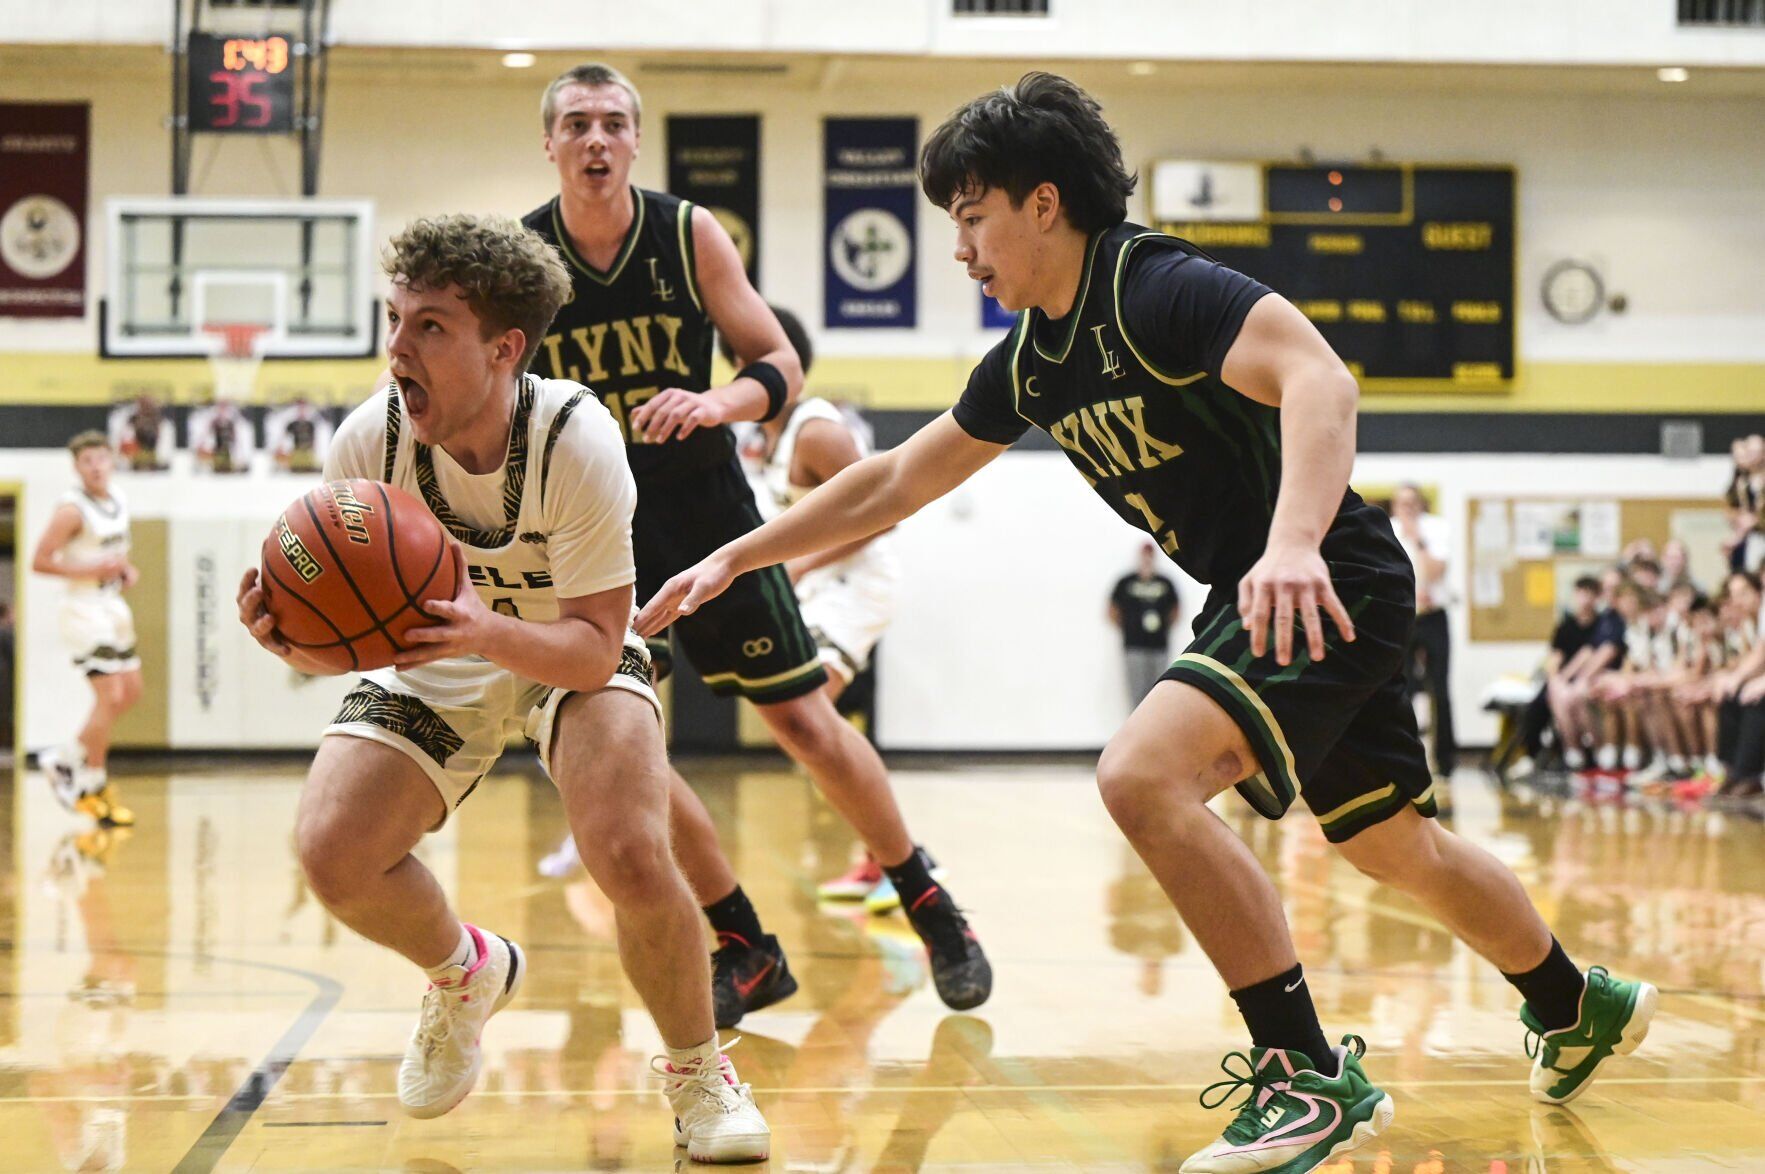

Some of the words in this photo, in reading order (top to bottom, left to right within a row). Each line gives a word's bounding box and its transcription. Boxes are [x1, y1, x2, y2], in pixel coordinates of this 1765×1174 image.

[209, 72, 272, 127] 35
[543, 313, 691, 383] LYNX
[1050, 395, 1185, 488] YNX
[286, 543, 320, 580] PRO
